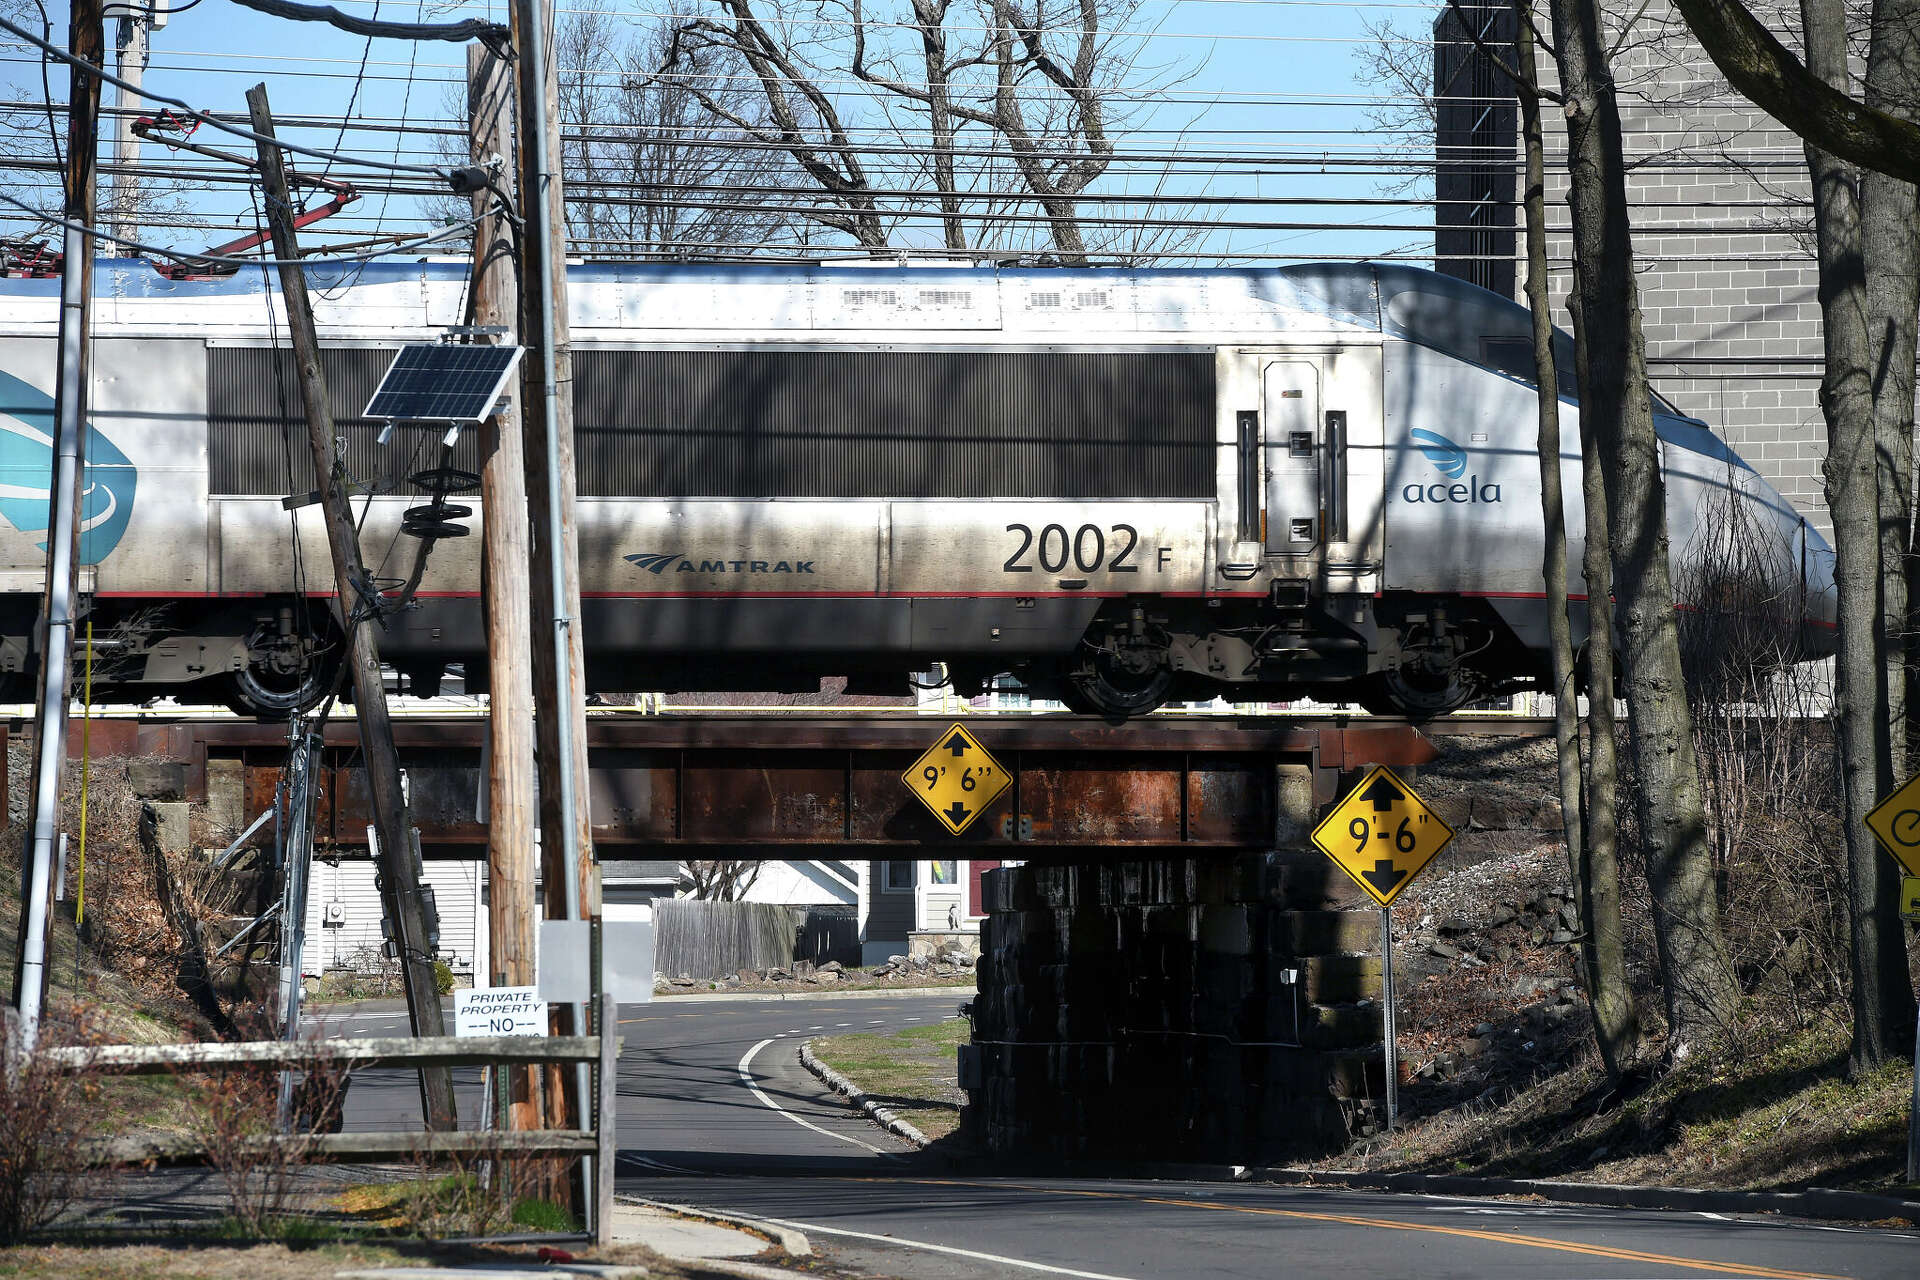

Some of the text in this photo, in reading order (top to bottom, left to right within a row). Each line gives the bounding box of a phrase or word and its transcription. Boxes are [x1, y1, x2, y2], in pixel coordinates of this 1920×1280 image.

[1402, 474, 1502, 504] acela
[1003, 523, 1172, 573] 2002 F
[676, 560, 815, 574] AMTRAK
[470, 992, 532, 1003] PRIVATE
[460, 1003, 542, 1015] PROPERTY
